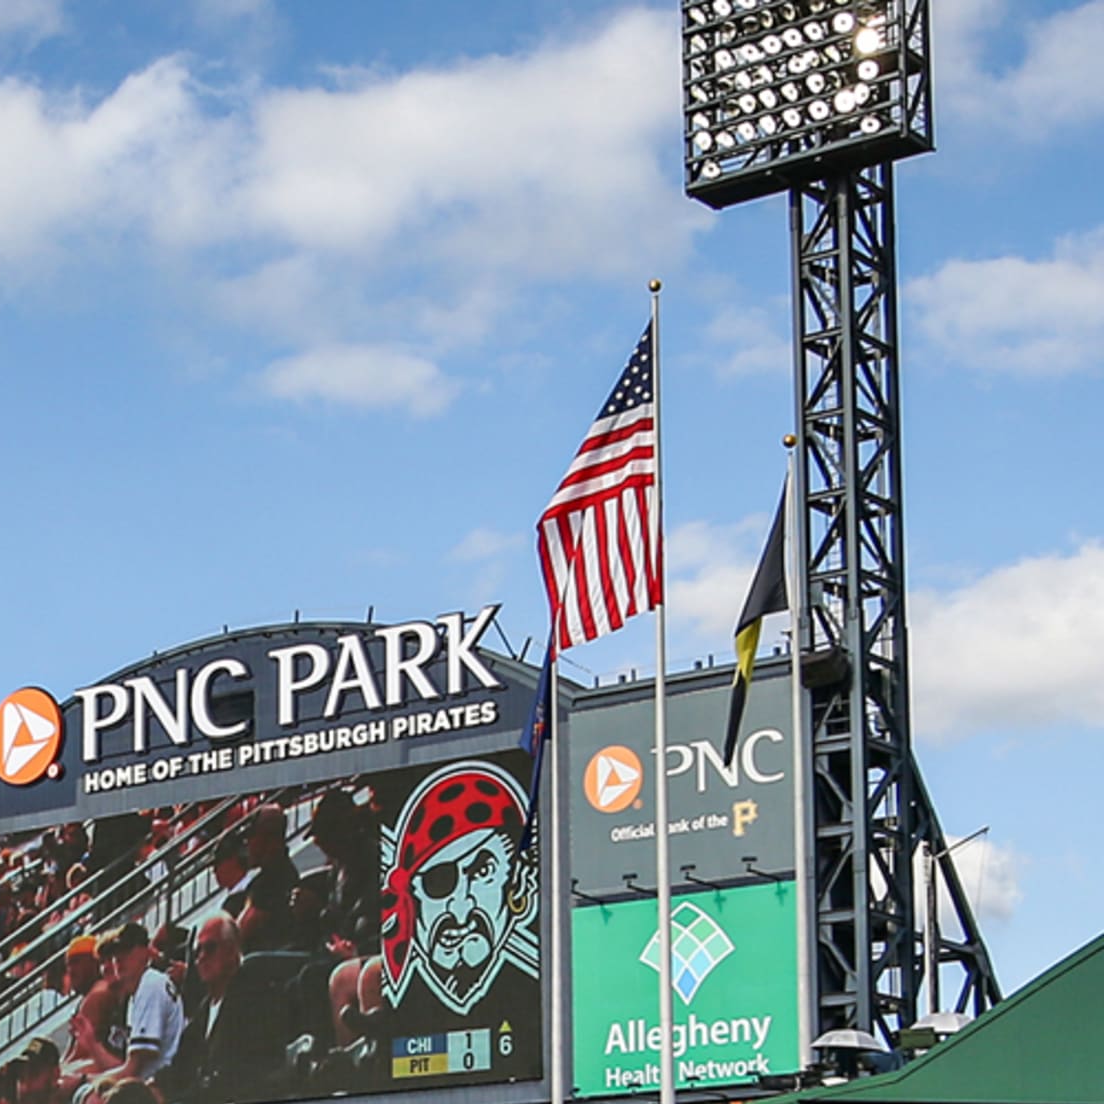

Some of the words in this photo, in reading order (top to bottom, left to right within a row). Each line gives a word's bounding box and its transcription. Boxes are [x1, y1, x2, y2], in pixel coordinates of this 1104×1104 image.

[73, 659, 248, 761] PNC
[269, 604, 502, 725] PARK
[84, 764, 146, 794] HOME
[152, 758, 182, 781] OF
[187, 747, 233, 774] THE
[240, 720, 385, 767] PITTSBURGH
[394, 701, 497, 739] PIRATES
[611, 824, 655, 843] Official
[668, 820, 690, 834] ank
[691, 816, 704, 831] of
[707, 814, 729, 829] the
[406, 1037, 432, 1054] CHI
[464, 1032, 473, 1050] 1
[499, 1035, 512, 1055] 6
[604, 1014, 772, 1058] Allegheny
[409, 1057, 431, 1073] PIT
[463, 1053, 474, 1069] 0
[605, 1063, 660, 1088] Healt
[679, 1053, 770, 1082] Network
